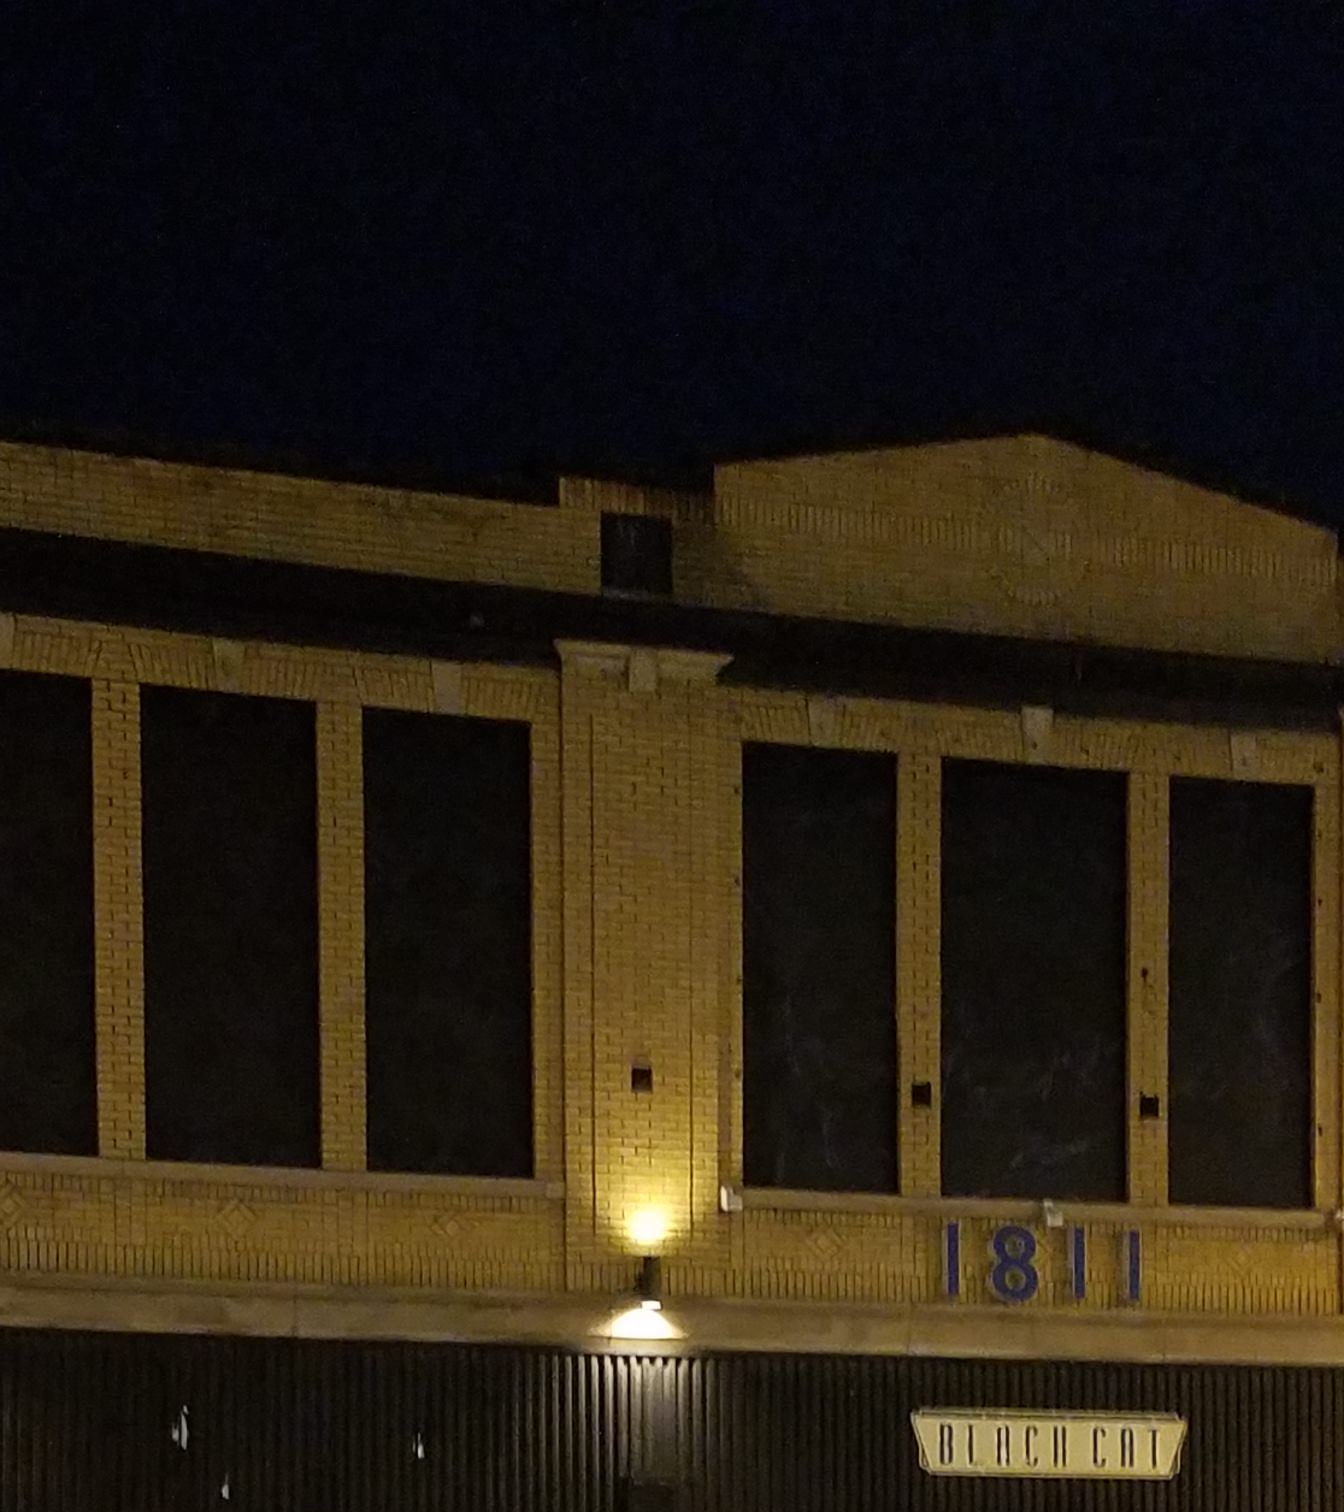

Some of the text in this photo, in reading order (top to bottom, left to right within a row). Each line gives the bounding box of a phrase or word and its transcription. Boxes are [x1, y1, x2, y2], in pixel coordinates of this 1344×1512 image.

[942, 1222, 1142, 1301] 1811
[938, 1423, 1163, 1470] BLACK CAT
